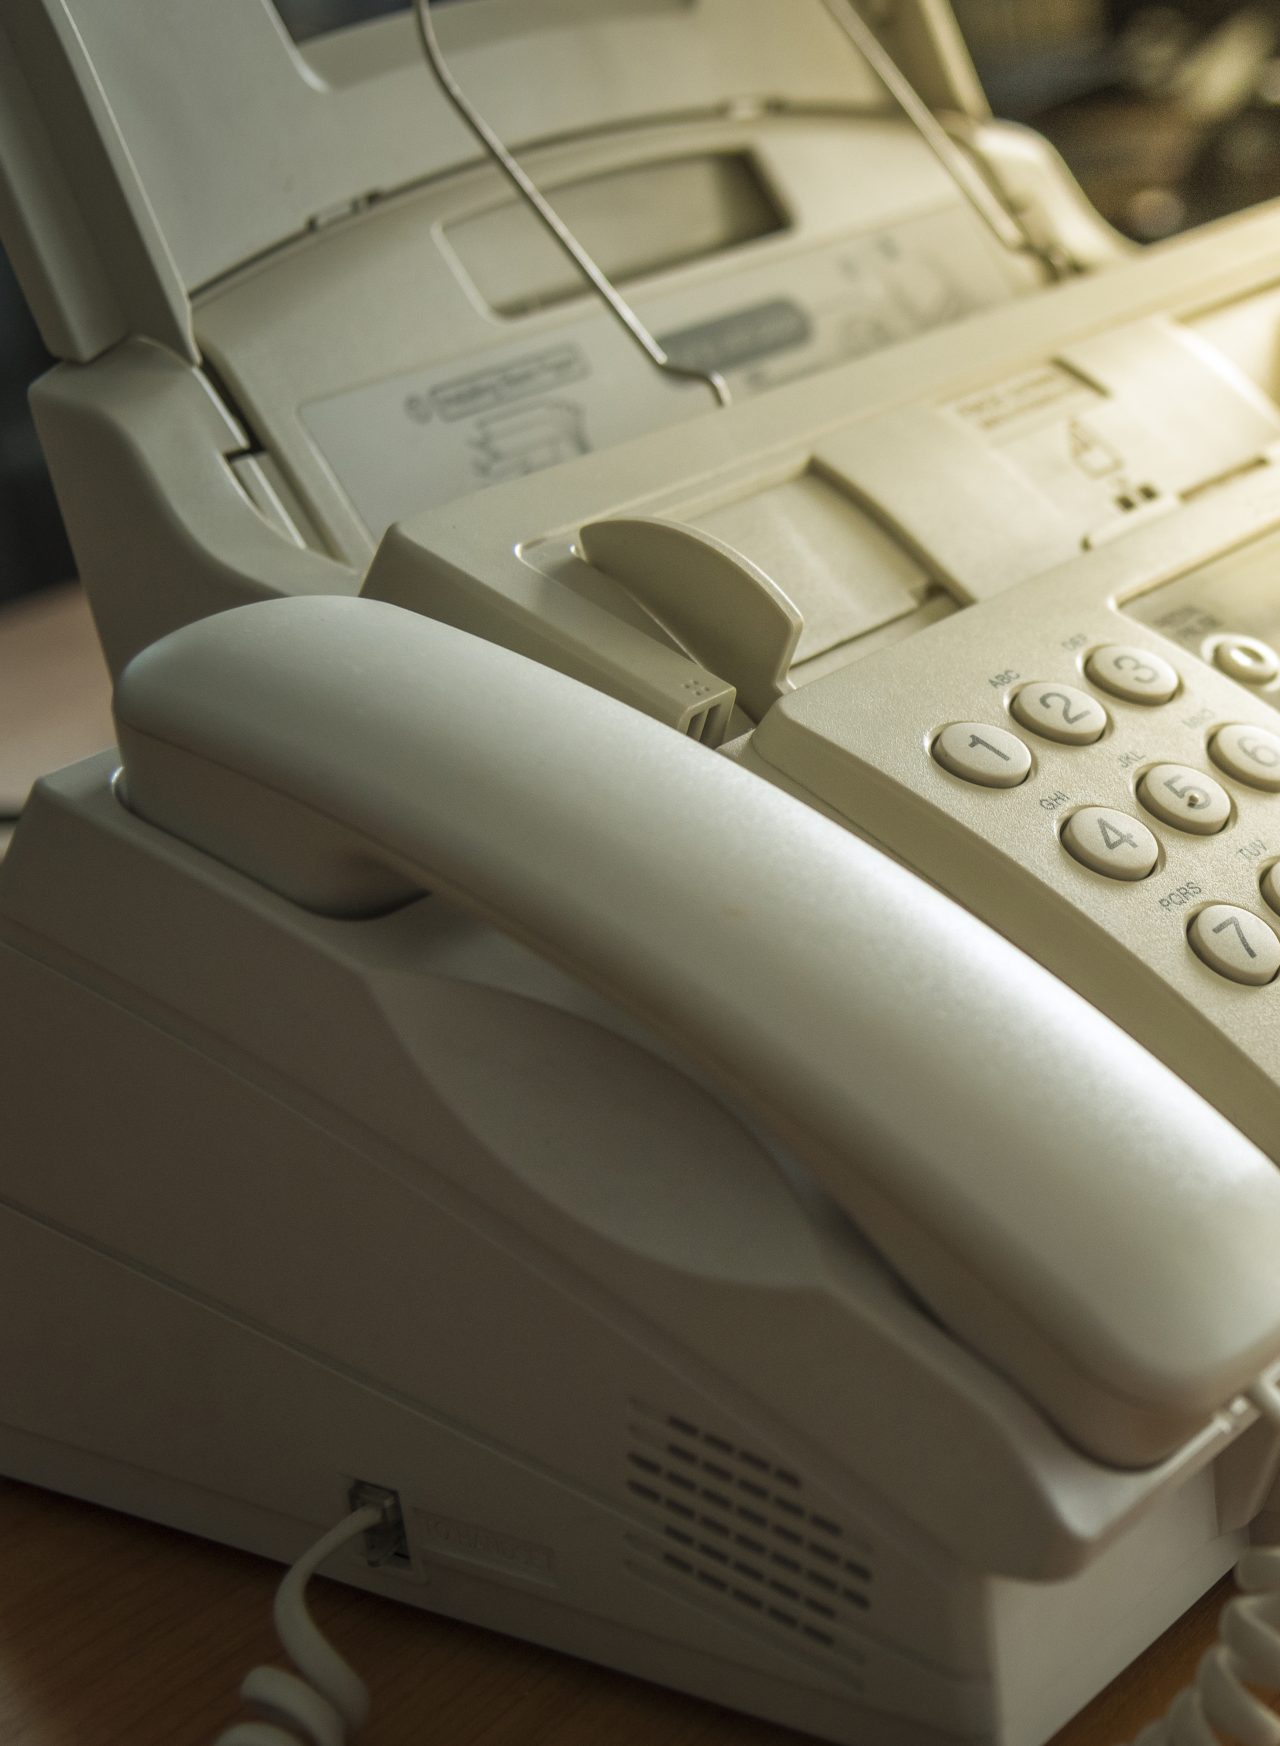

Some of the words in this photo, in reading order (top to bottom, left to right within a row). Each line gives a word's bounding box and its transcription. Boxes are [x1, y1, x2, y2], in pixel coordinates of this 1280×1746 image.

[1061, 633, 1088, 651] DEF
[988, 669, 1020, 689] ABC
[1113, 655, 1158, 685] 3
[1039, 692, 1091, 725] 2
[967, 733, 1010, 762] 1
[1117, 751, 1146, 769] JKL
[1238, 738, 1280, 768] 6
[1039, 790, 1070, 810] GHI
[1163, 775, 1212, 810] 5
[1096, 817, 1138, 852] 4
[1236, 839, 1267, 859] TUV
[1158, 881, 1202, 912] PQRS
[1212, 916, 1257, 959] 7
